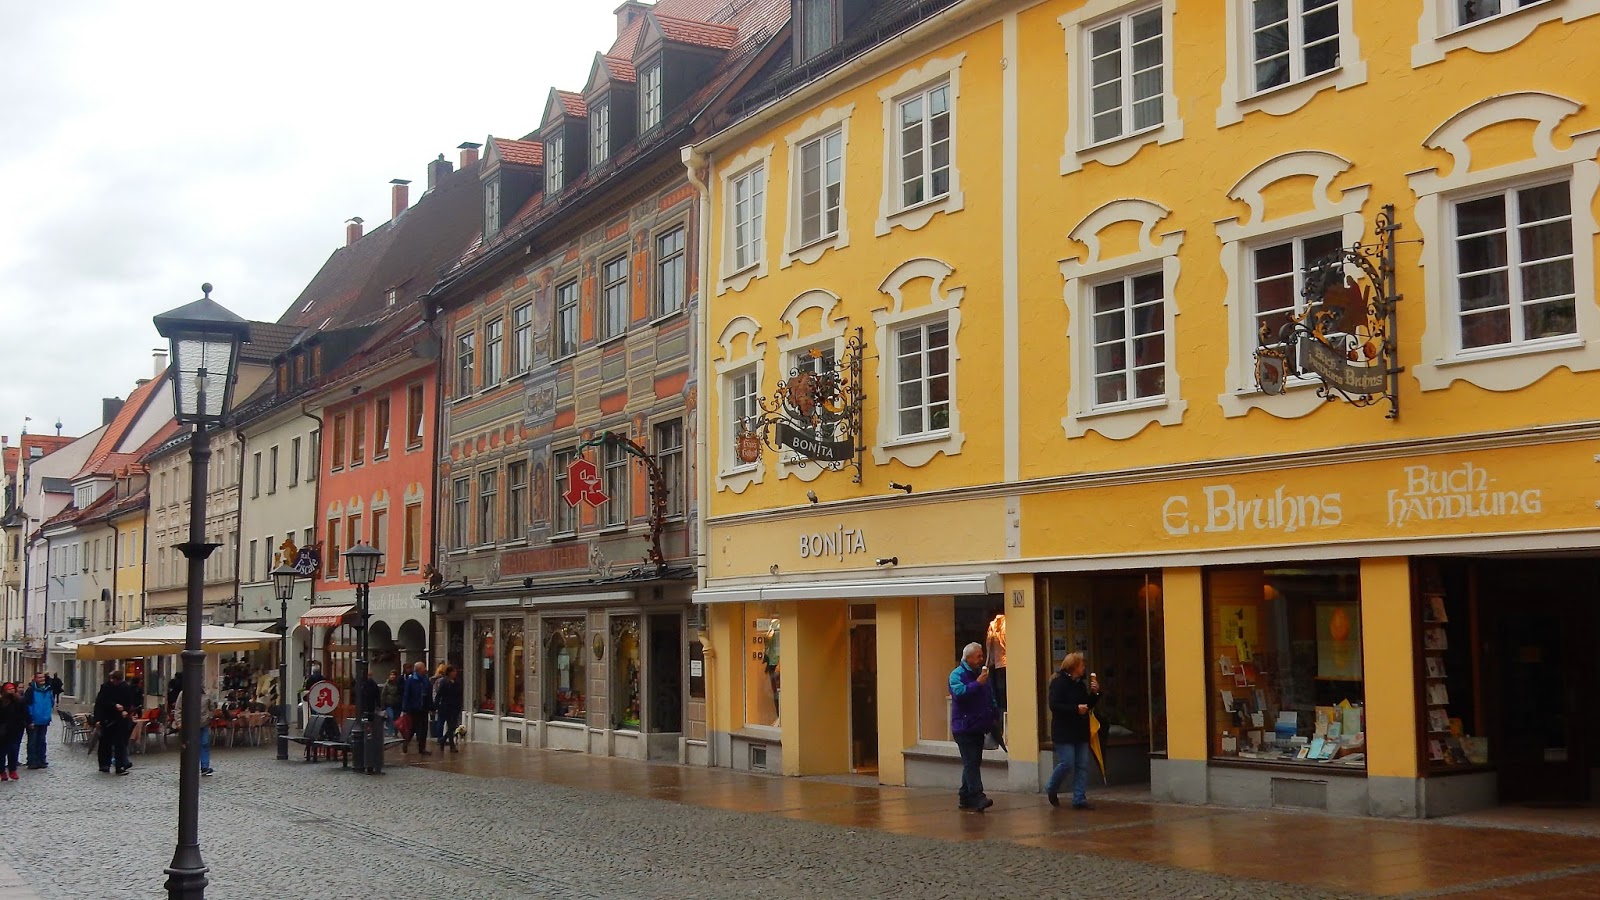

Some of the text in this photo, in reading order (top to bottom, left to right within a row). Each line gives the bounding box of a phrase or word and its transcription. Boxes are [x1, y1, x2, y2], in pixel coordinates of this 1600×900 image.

[792, 437, 834, 458] BONITA
[800, 523, 866, 562] BONITA
[1013, 591, 1023, 605] 10
